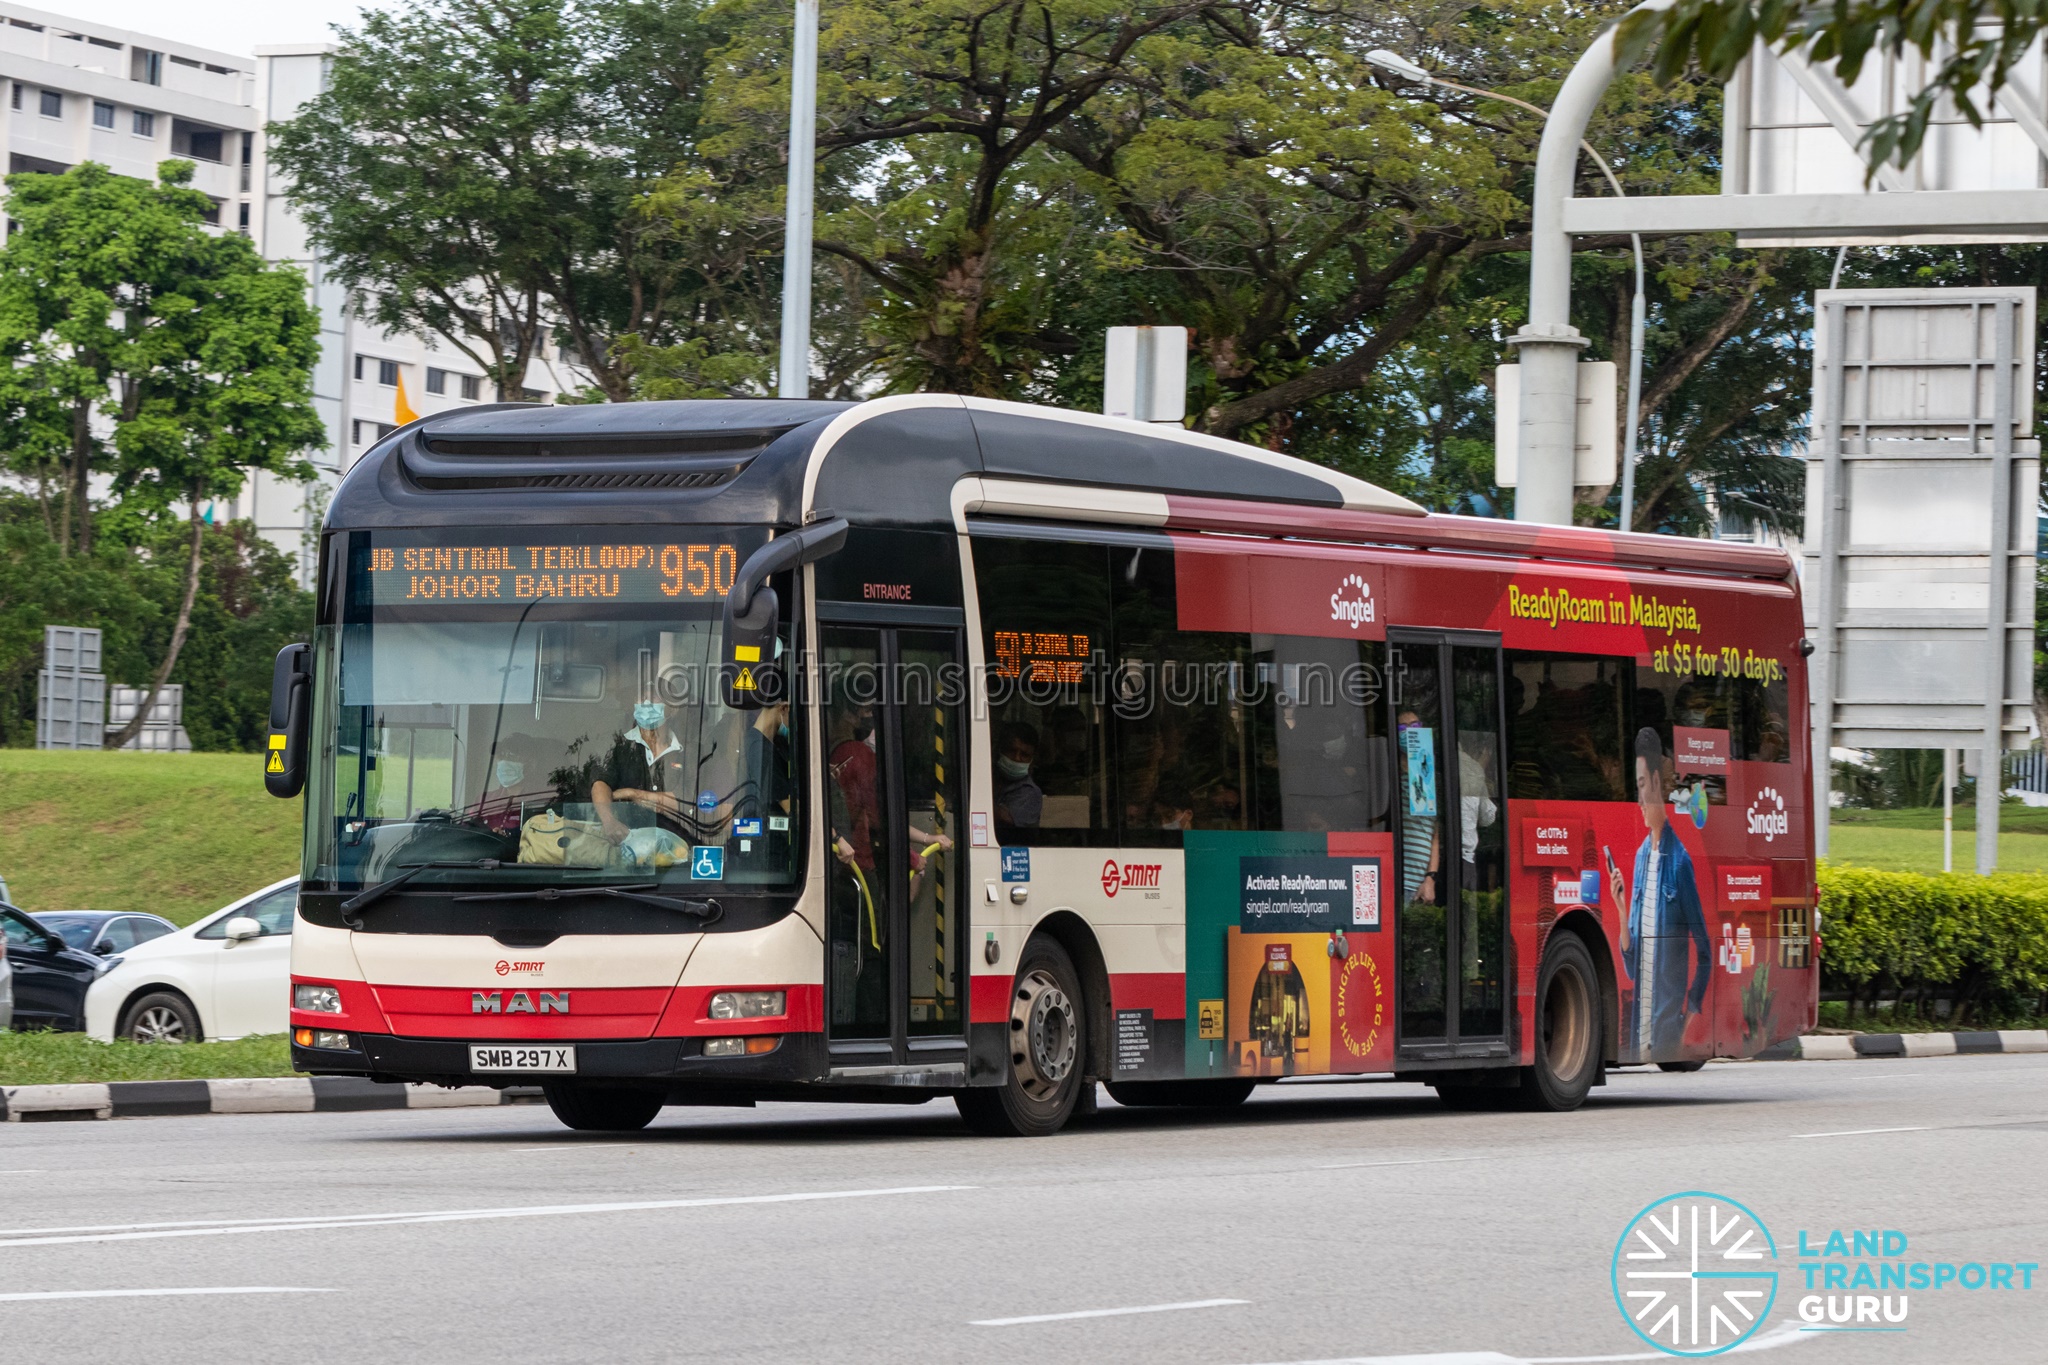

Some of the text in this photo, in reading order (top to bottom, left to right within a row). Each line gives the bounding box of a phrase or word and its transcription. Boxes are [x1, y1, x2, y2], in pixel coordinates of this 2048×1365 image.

[368, 546, 653, 571] JB SENTRAL TER(LOOP)
[660, 545, 736, 596] 950
[406, 574, 619, 598] JOHOR BAHRU
[863, 583, 911, 600] ENTRANCE
[1331, 594, 1375, 629] Singtel
[1508, 584, 1701, 636] ReadyRoam in Malaysia,
[1654, 640, 1783, 687] at $5 for 30 days.
[1536, 827, 1547, 839] Get
[1747, 807, 1788, 842] Singtel
[1536, 843, 1551, 854] bank
[1121, 864, 1162, 886] SMRT
[1246, 874, 1347, 895] Activate ReadyRoam now.
[1246, 897, 1329, 918] singtel.com/readyroam
[512, 962, 545, 971] SMRT
[472, 991, 570, 1014] MAN
[1338, 951, 1383, 1057] SINGTEL LIFE IN SG LIFE WITH
[477, 1050, 568, 1067] SMB 297 X
